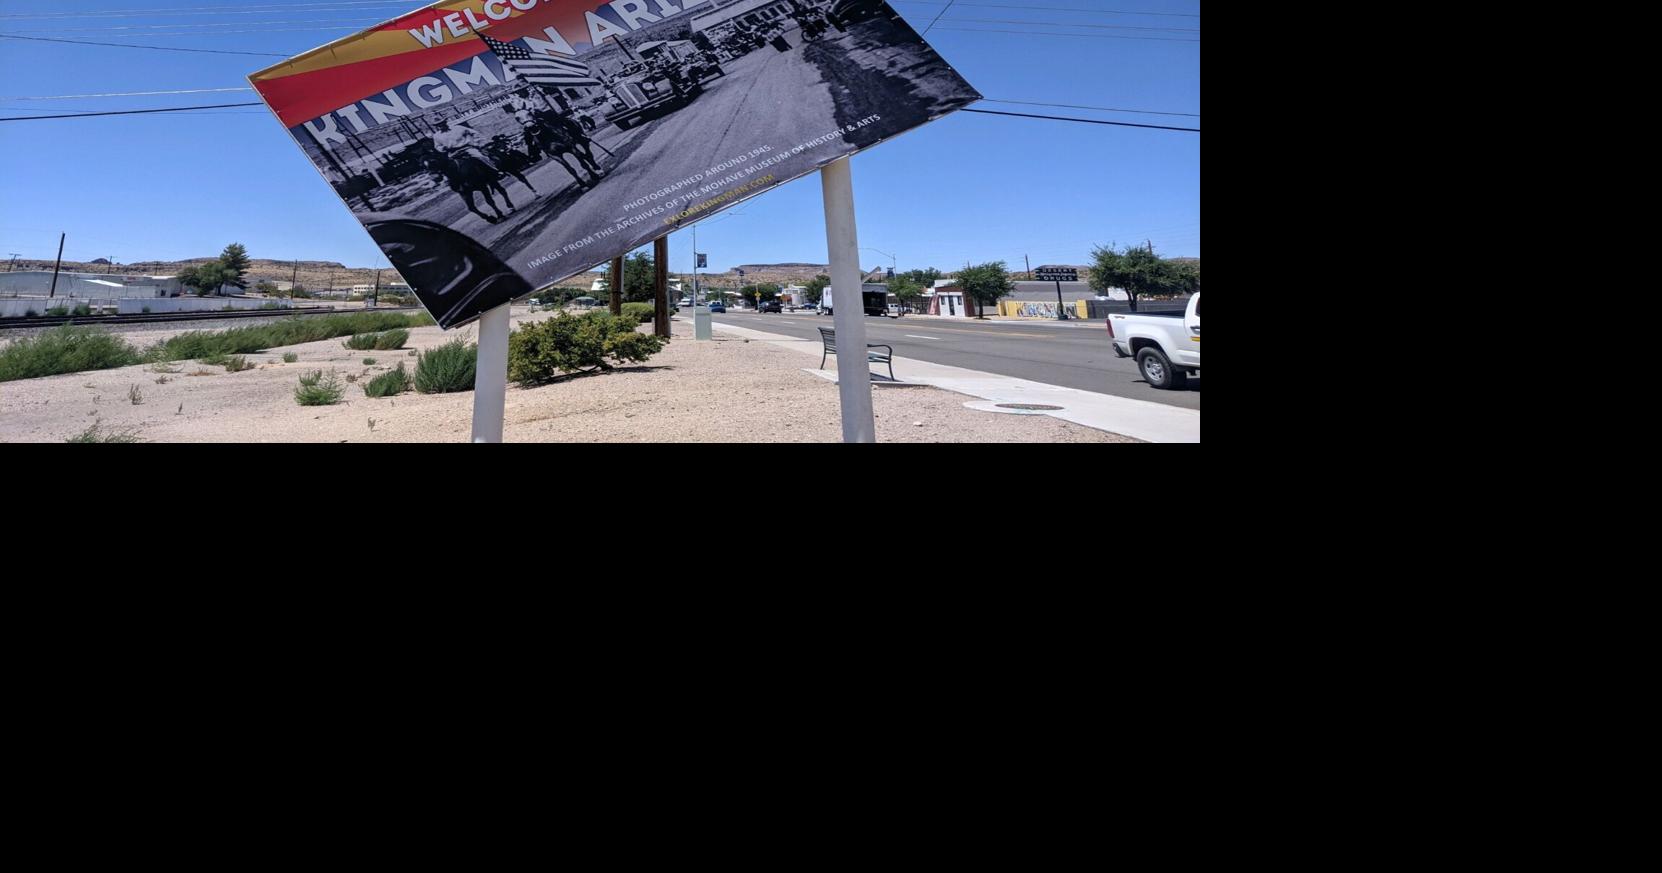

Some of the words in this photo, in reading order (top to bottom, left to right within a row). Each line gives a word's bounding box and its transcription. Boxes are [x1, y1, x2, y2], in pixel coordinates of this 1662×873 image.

[408, 0, 550, 48] WELC
[584, 0, 708, 47] ARI
[527, 249, 563, 269] IMAGE
[562, 235, 594, 254] FROM
[594, 226, 615, 240] THE
[616, 205, 665, 231] ARCHIVES
[665, 198, 680, 210] OF
[680, 190, 700, 203] THE
[700, 172, 745, 194] MOHAVE
[745, 150, 791, 176] MUSEUM
[791, 144, 806, 155] OF
[806, 127, 847, 149] HISTORY
[847, 124, 856, 132] &
[857, 113, 881, 130] ARTS
[623, 174, 703, 212] PHOTOGRAPHED
[705, 154, 747, 178] AROUND
[747, 144, 775, 159] 1945.
